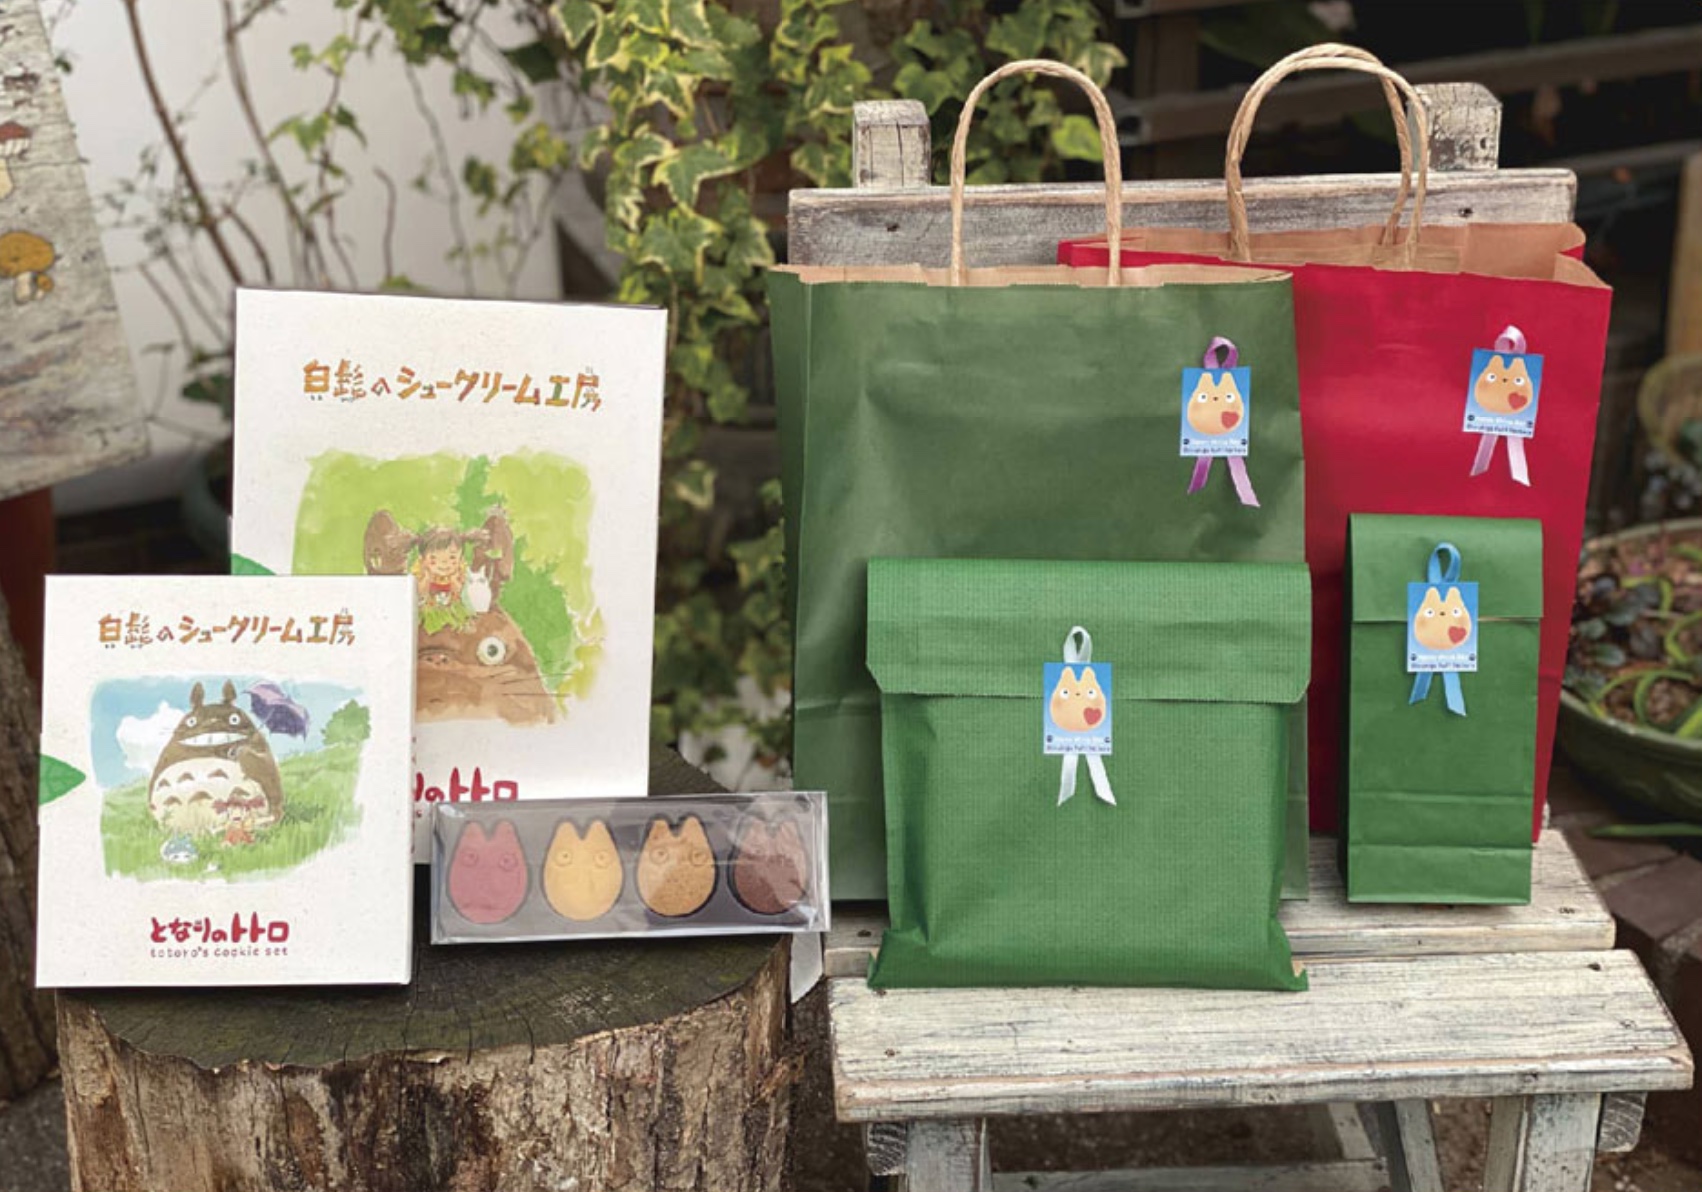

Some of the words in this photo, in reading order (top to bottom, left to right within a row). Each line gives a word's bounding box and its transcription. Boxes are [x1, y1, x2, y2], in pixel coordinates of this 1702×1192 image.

[303, 358, 602, 412] 白髭のシュークリーム工房
[97, 607, 356, 649] 白髭のシュークリーム工房
[150, 911, 290, 943] となりのトトロ
[213, 945, 260, 957] cookie
[264, 946, 288, 957] set
